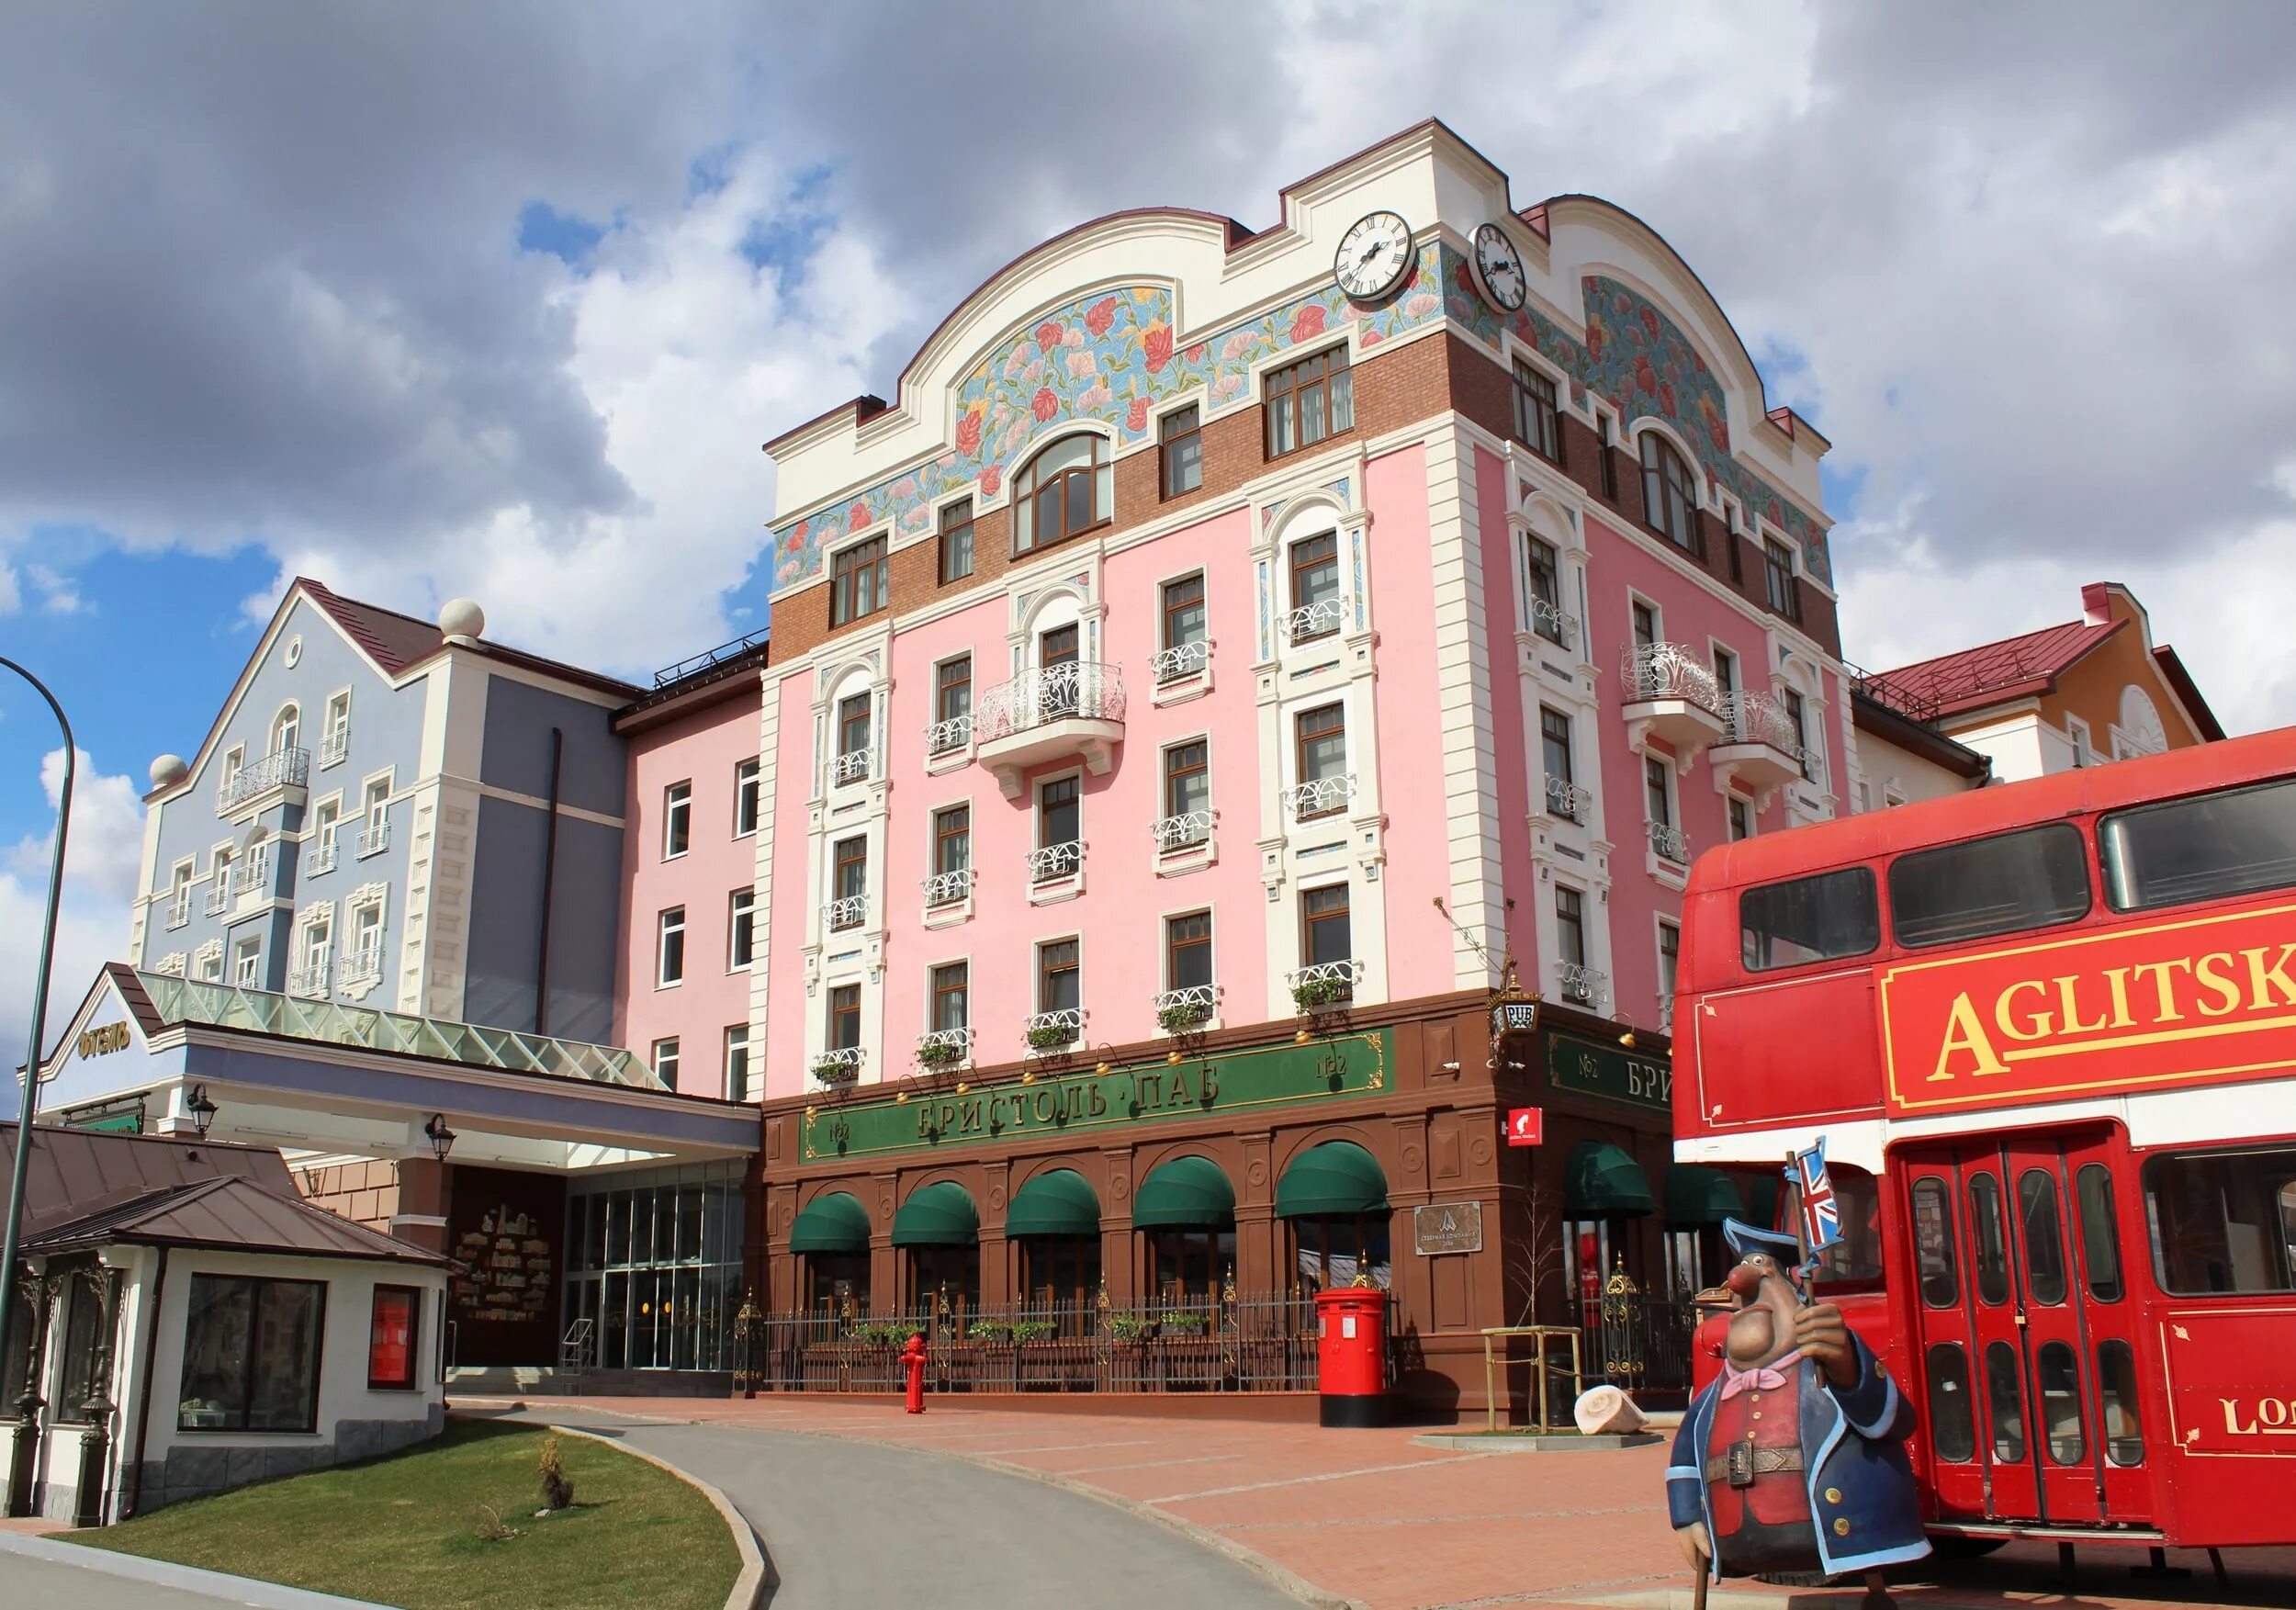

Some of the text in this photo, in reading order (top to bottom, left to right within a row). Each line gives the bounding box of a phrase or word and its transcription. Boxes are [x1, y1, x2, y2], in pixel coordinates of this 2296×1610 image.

[1507, 1007, 1533, 1020] PUB
[1926, 942, 2296, 1082] AGLITSK
[78, 1020, 131, 1060] ОТЕЛЬ
[918, 1066, 1219, 1138] БРИСТОЛЬ ПАБ
[1626, 1061, 1672, 1102] БРИ
